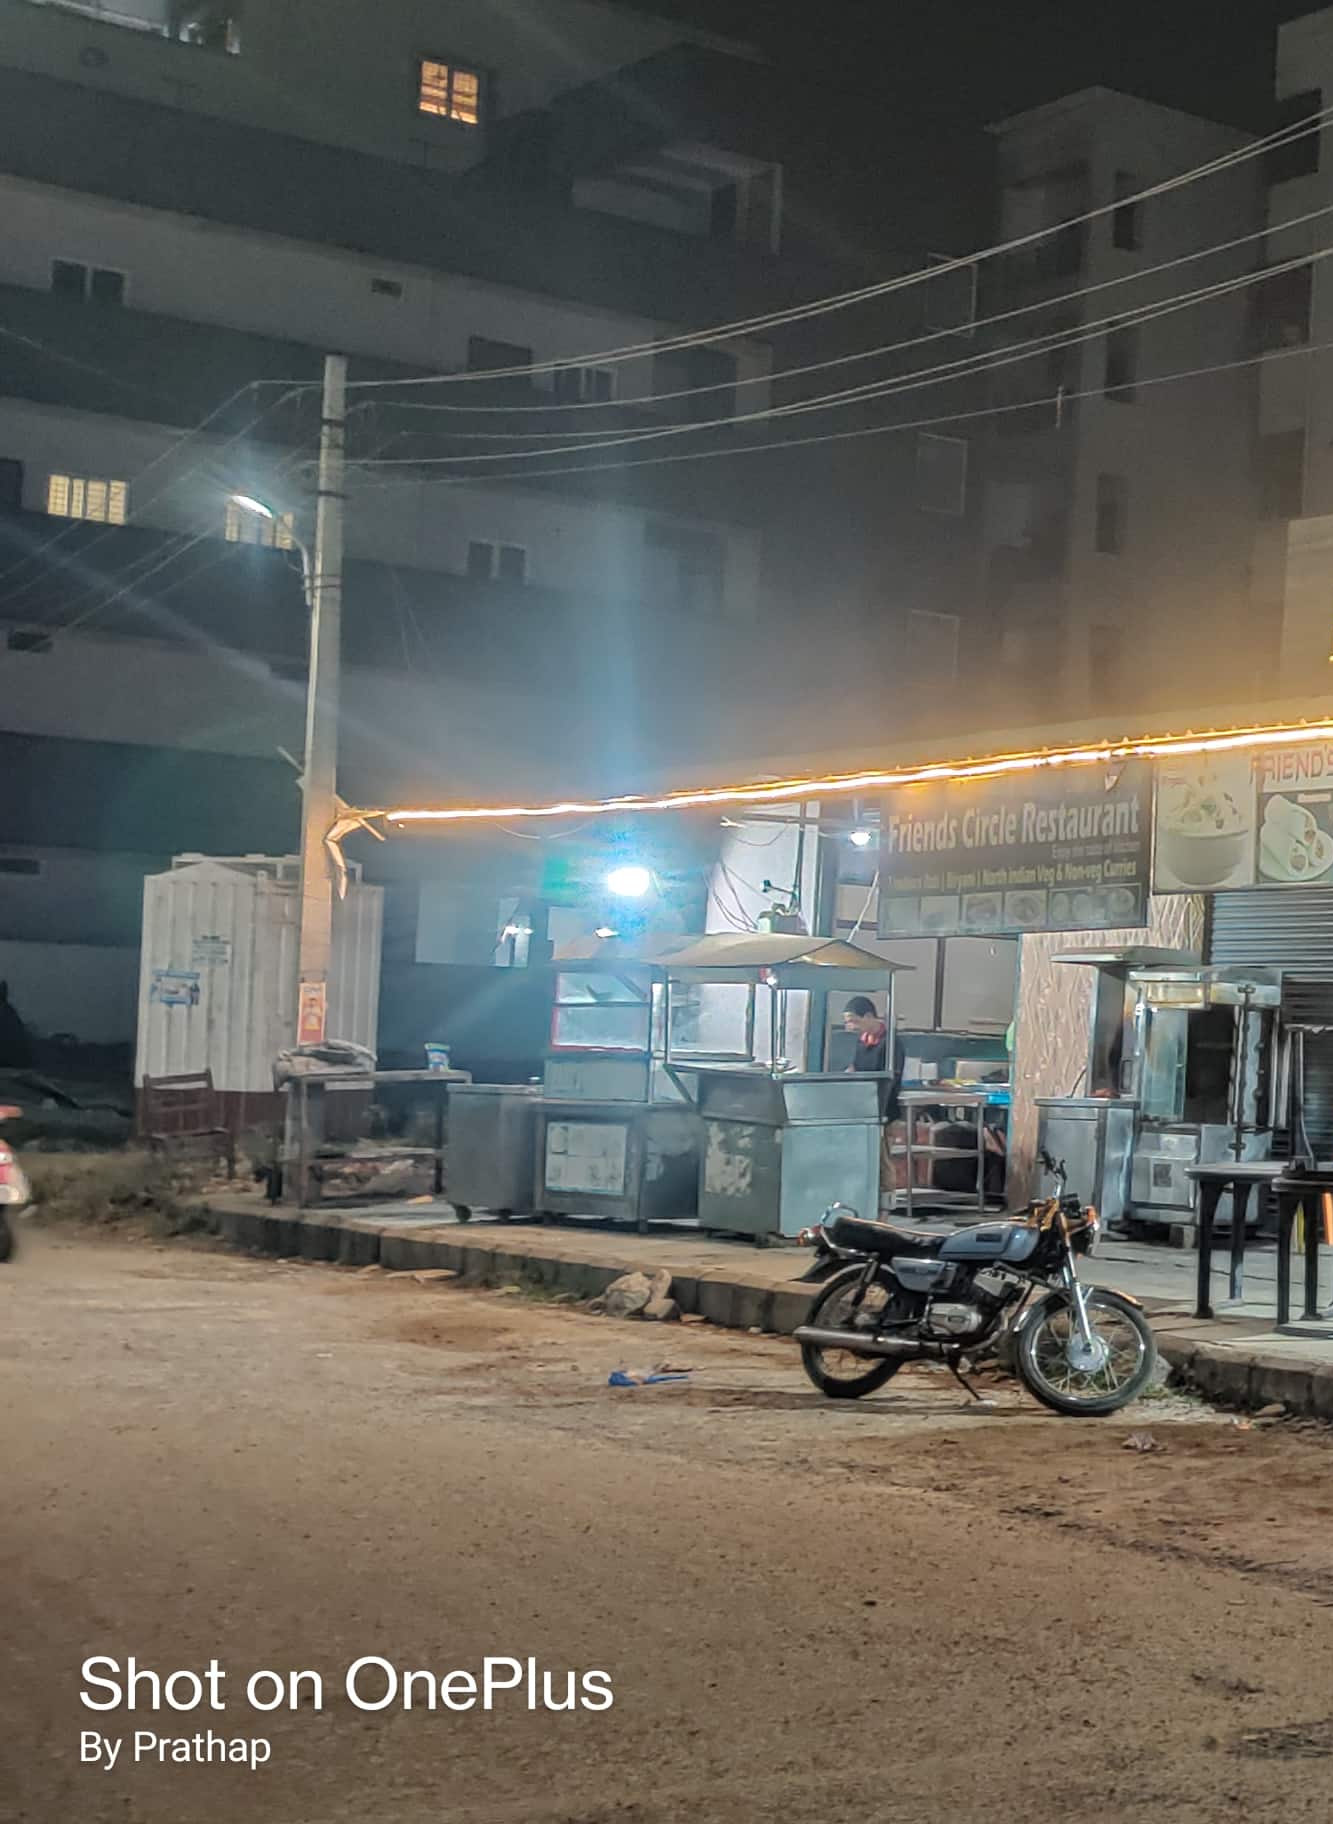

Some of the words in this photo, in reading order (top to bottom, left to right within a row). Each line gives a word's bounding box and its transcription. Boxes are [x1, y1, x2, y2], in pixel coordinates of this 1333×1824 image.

[888, 808, 957, 853] Friends
[962, 803, 1017, 848] Circle
[1022, 794, 1141, 843] Restaurant
